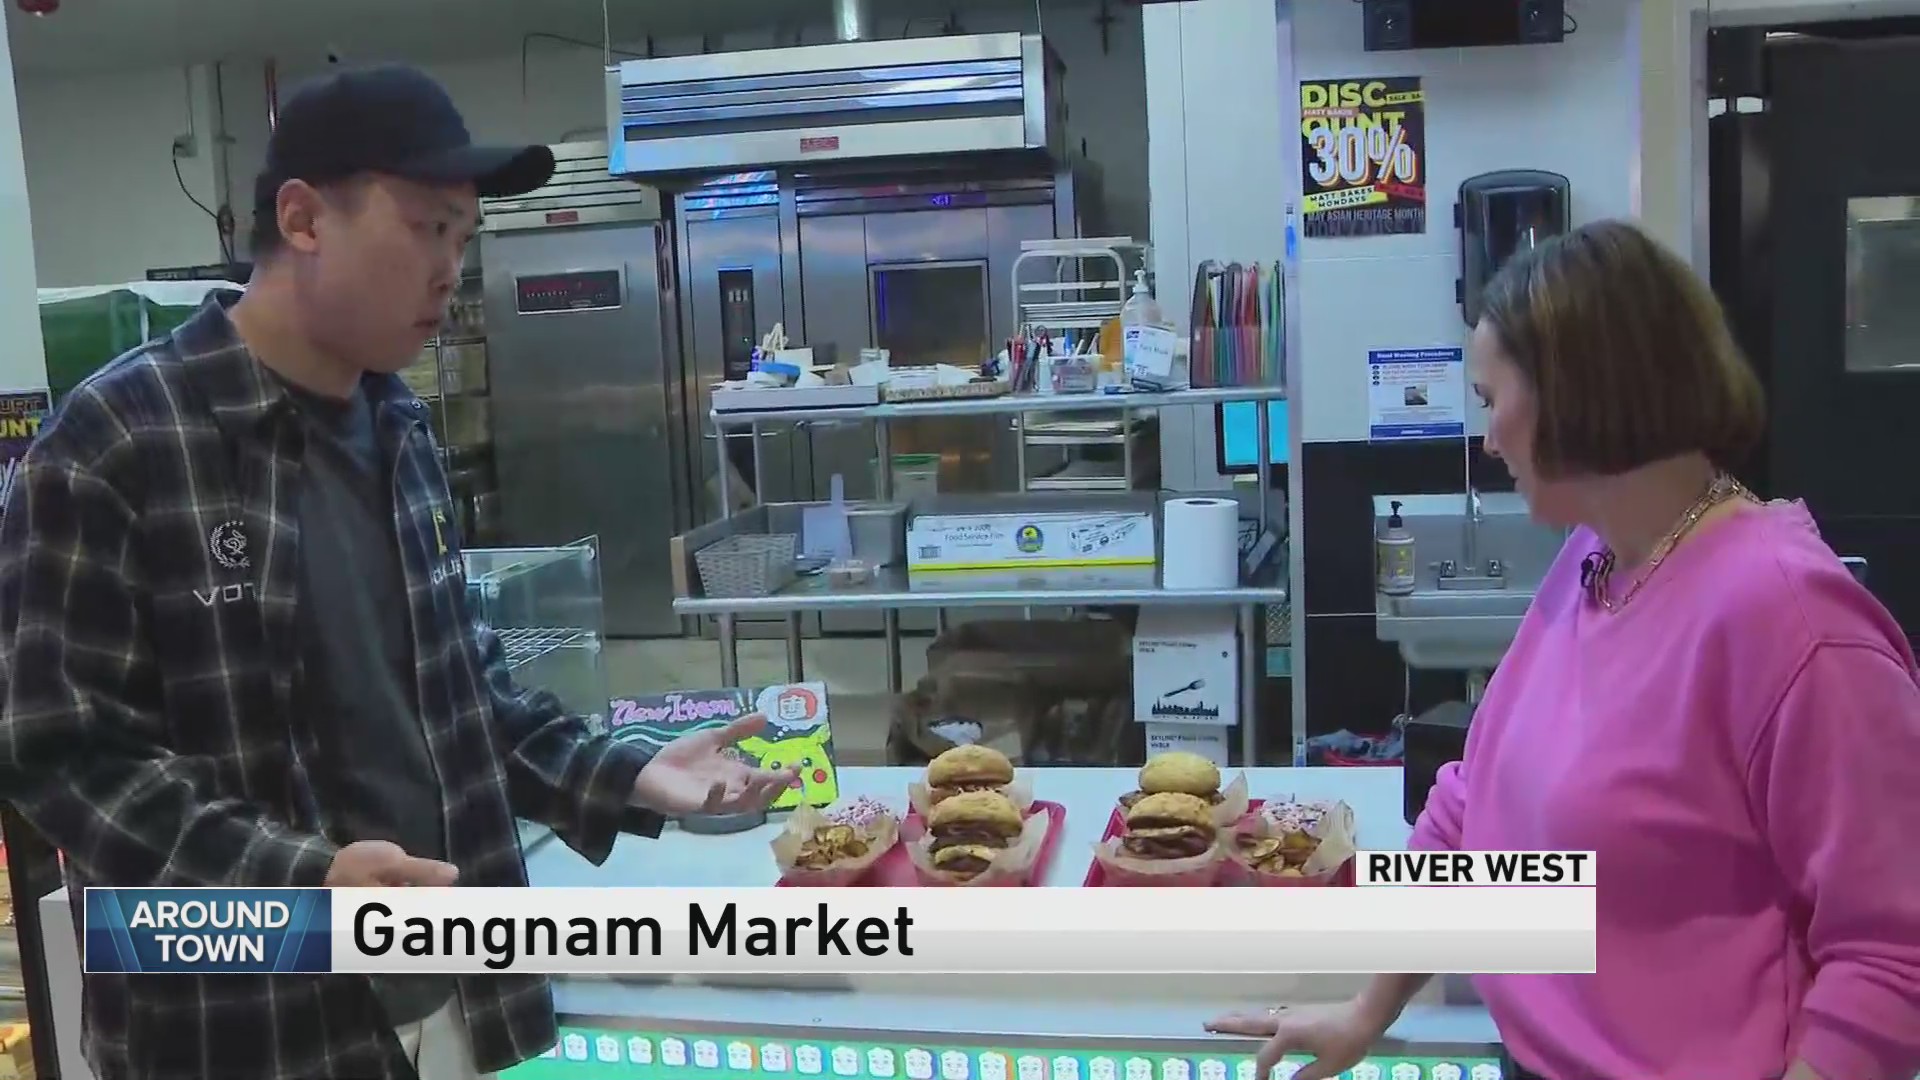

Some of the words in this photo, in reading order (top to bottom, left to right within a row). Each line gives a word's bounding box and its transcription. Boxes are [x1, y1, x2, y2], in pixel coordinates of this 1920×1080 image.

[1301, 81, 1386, 108] DISC
[1308, 124, 1414, 186] 30%
[1310, 192, 1335, 202] MATT
[1340, 187, 1373, 198] BAKES
[1318, 196, 1367, 208] MONDAYS
[1307, 212, 1325, 222] MAY
[1326, 210, 1352, 222] ASIAN
[1353, 208, 1393, 220] HERITAGE
[1394, 207, 1425, 220] MONTH
[945, 533, 964, 541] Food
[964, 532, 989, 540] Service
[610, 698, 670, 727] New
